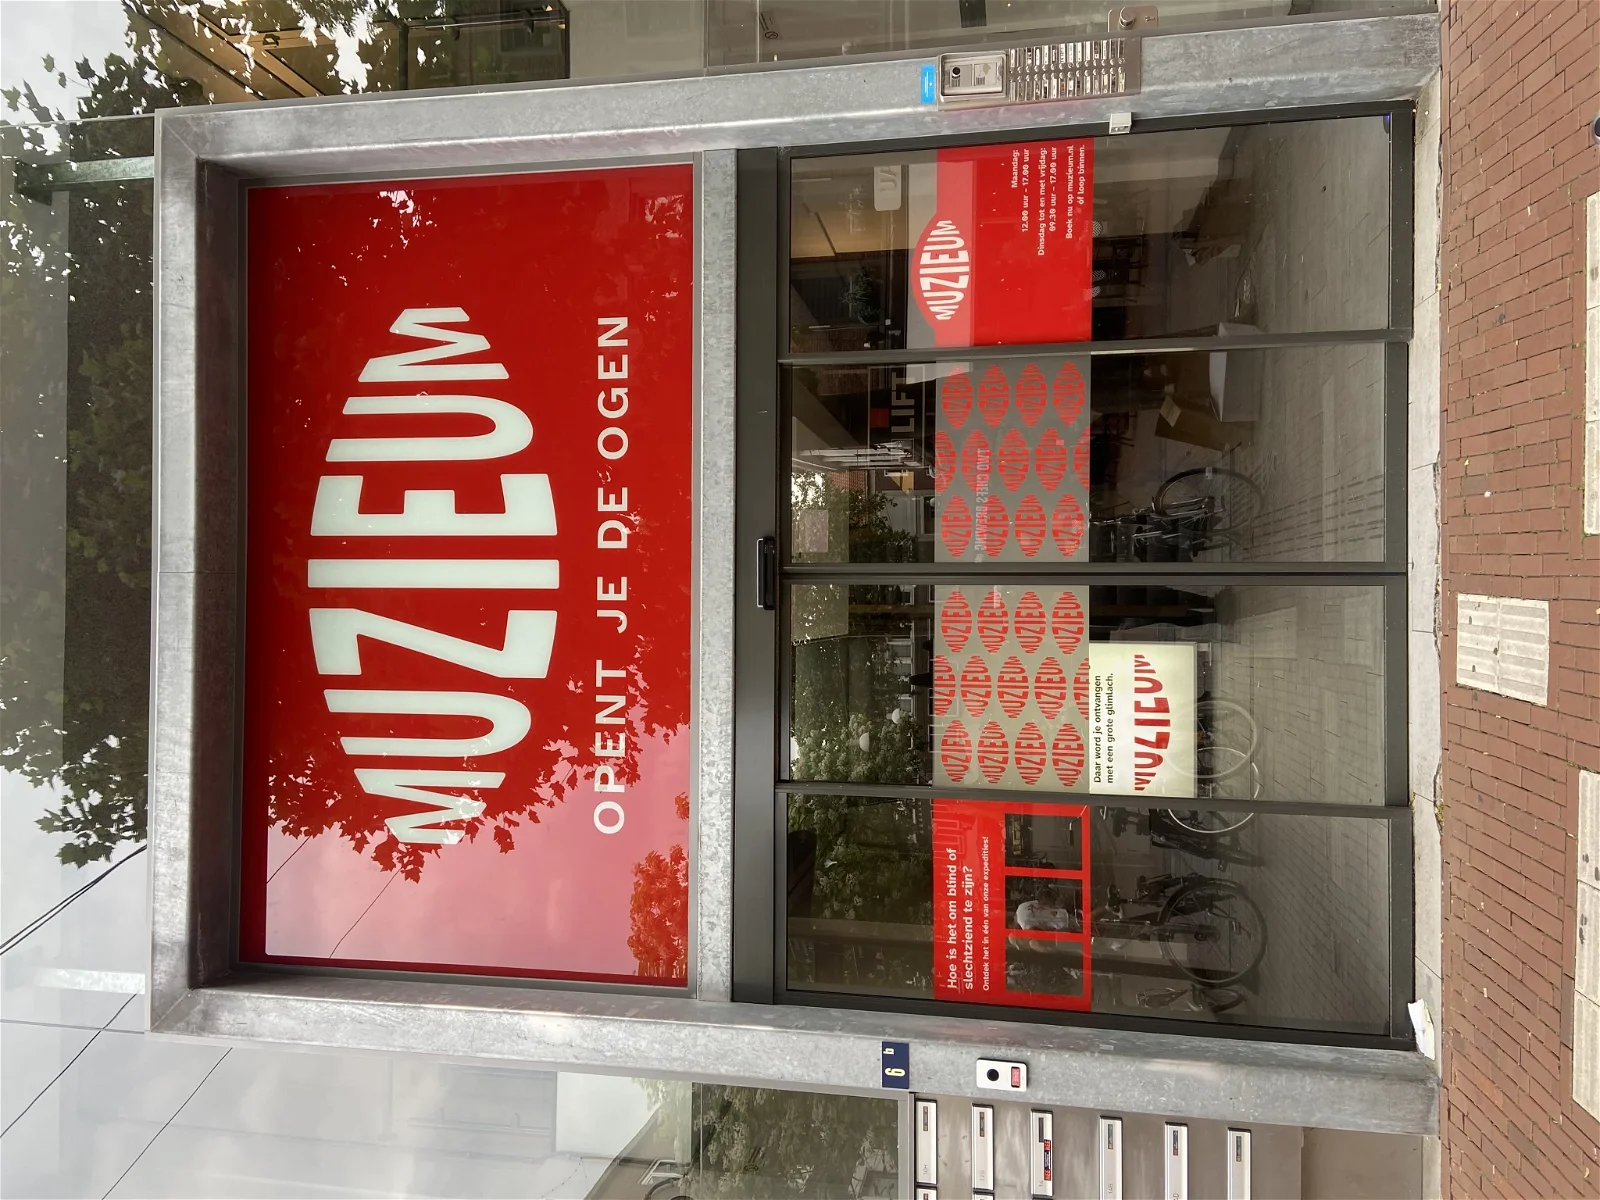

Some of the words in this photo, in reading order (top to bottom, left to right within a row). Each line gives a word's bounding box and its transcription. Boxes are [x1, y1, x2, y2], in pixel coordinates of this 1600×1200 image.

[1011, 149, 1019, 188] Maandag:
[1038, 147, 1047, 177] vrijdag:
[1039, 197, 1045, 207] en
[1067, 194, 1074, 204] op
[1077, 176, 1085, 194] loop
[1067, 206, 1072, 216] nu
[1037, 223, 1046, 256] Dinsdag
[920, 220, 970, 320] MUZIEUM
[597, 316, 629, 460] OGEN
[891, 372, 915, 433] LIFT
[597, 487, 629, 549] DE
[307, 306, 560, 845] MUZIEUM
[596, 575, 628, 633] JE
[941, 591, 972, 653] MUZIEUM
[977, 591, 1009, 653] MUZIEUM
[1014, 591, 1047, 654] MUZIEUM
[1051, 591, 1084, 654] MUZIEUM
[960, 656, 992, 718] MUZIEUM
[997, 656, 1029, 718] MUZIEUM
[1034, 656, 1067, 720] MUZIEUM
[1094, 675, 1102, 723] ontvangen
[1105, 673, 1115, 716] glimlach.
[593, 659, 627, 835] OPENT
[1093, 725, 1102, 735] je
[1093, 737, 1101, 759] word
[1106, 718, 1115, 743] grote
[940, 720, 972, 782] MUZIEUM
[977, 721, 1009, 784] MUZIEUM
[1014, 722, 1046, 785] MUZIEUM
[1052, 723, 1085, 786] MUZIEUM
[1093, 761, 1101, 783] Daar
[946, 848, 956, 861] of
[982, 836, 990, 880] expedities!
[946, 865, 957, 896] blind
[962, 865, 974, 896] zijn?
[949, 900, 957, 920] om
[963, 900, 973, 913] te
[981, 919, 989, 934] één
[946, 948, 957, 959] is
[947, 924, 957, 944] het
[962, 916, 973, 990] slechtziend
[982, 936, 989, 944] in
[946, 963, 957, 989] Hoe
[884, 1067, 905, 1077] 6
